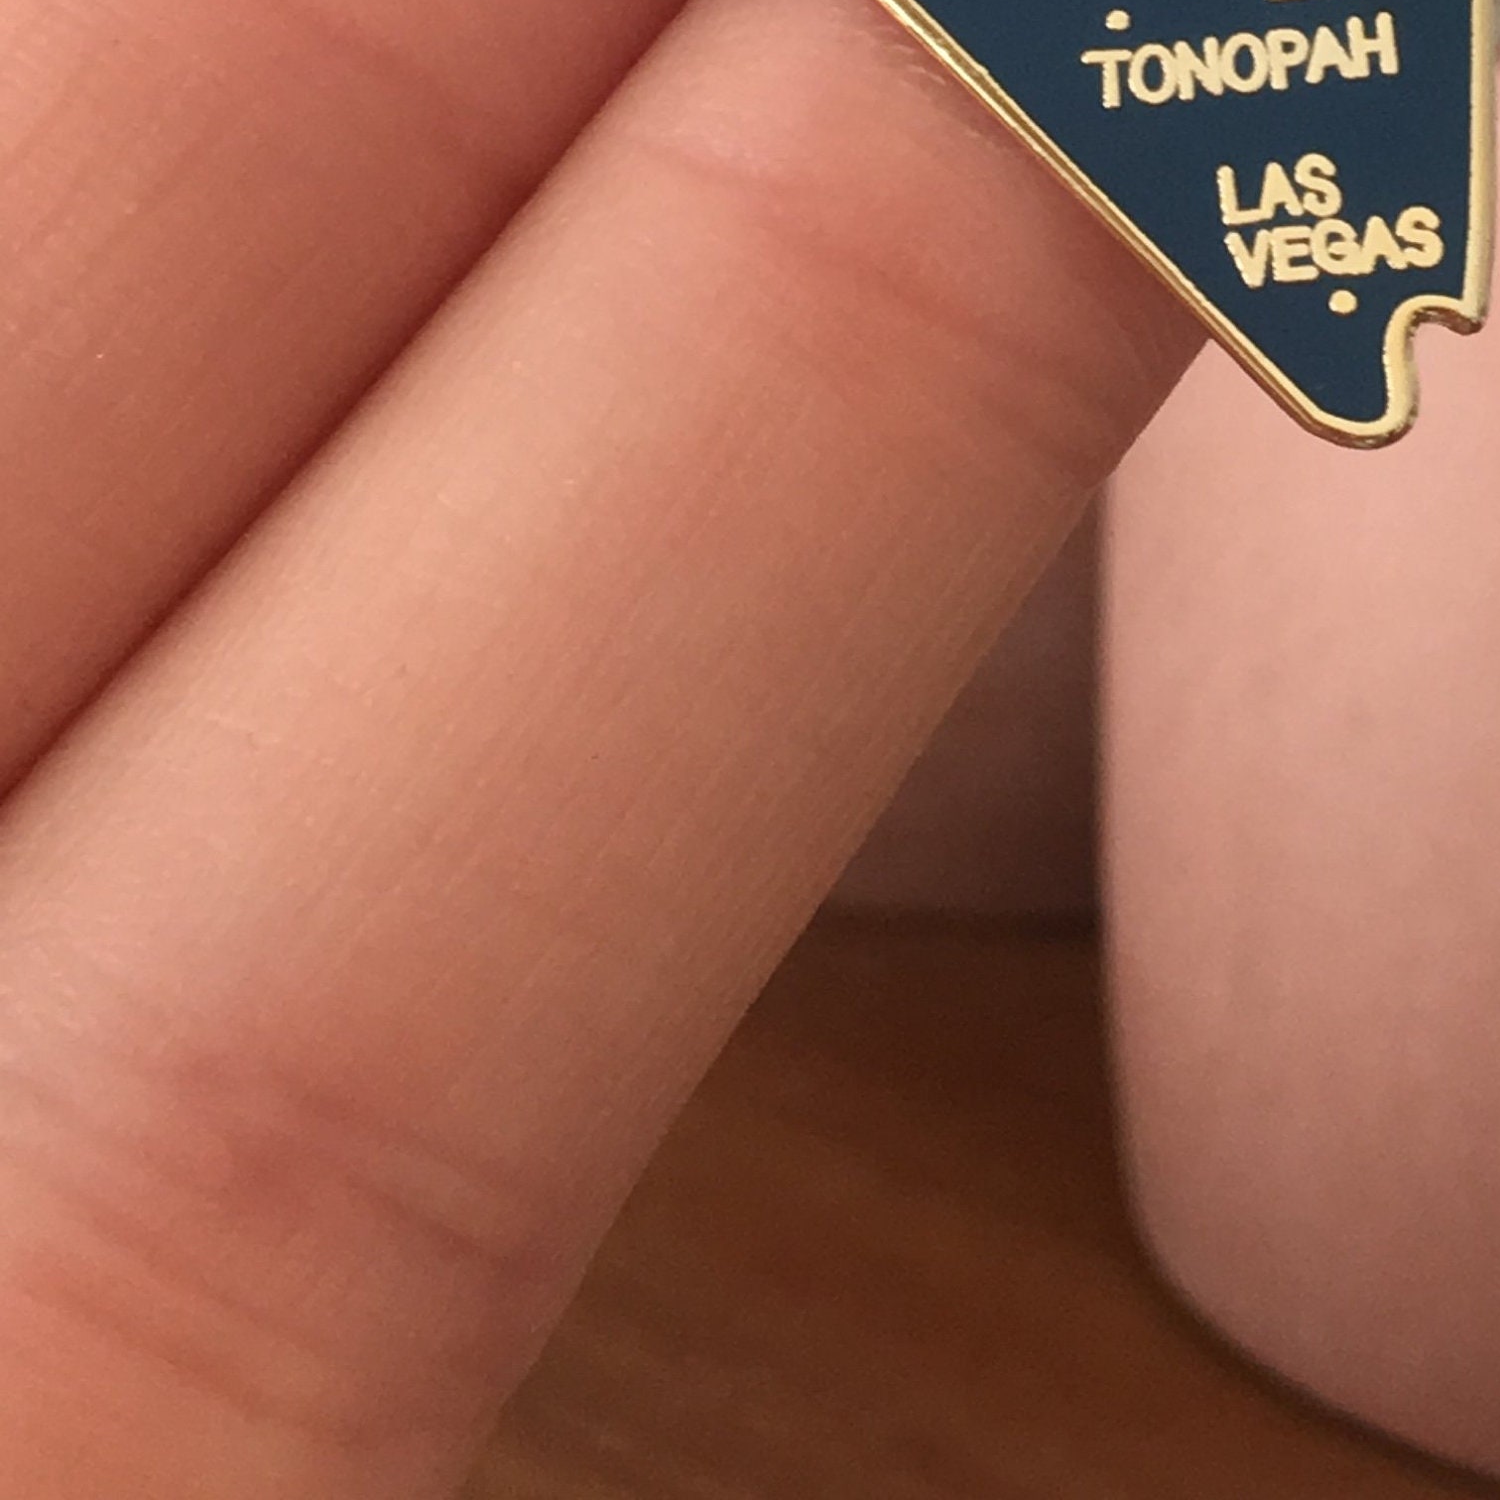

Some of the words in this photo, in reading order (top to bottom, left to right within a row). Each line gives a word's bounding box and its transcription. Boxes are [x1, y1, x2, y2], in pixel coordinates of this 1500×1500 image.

[1080, 11, 1399, 109] TONOPAH
[1216, 152, 1342, 225] LAS
[1223, 205, 1444, 289] VEGAS
